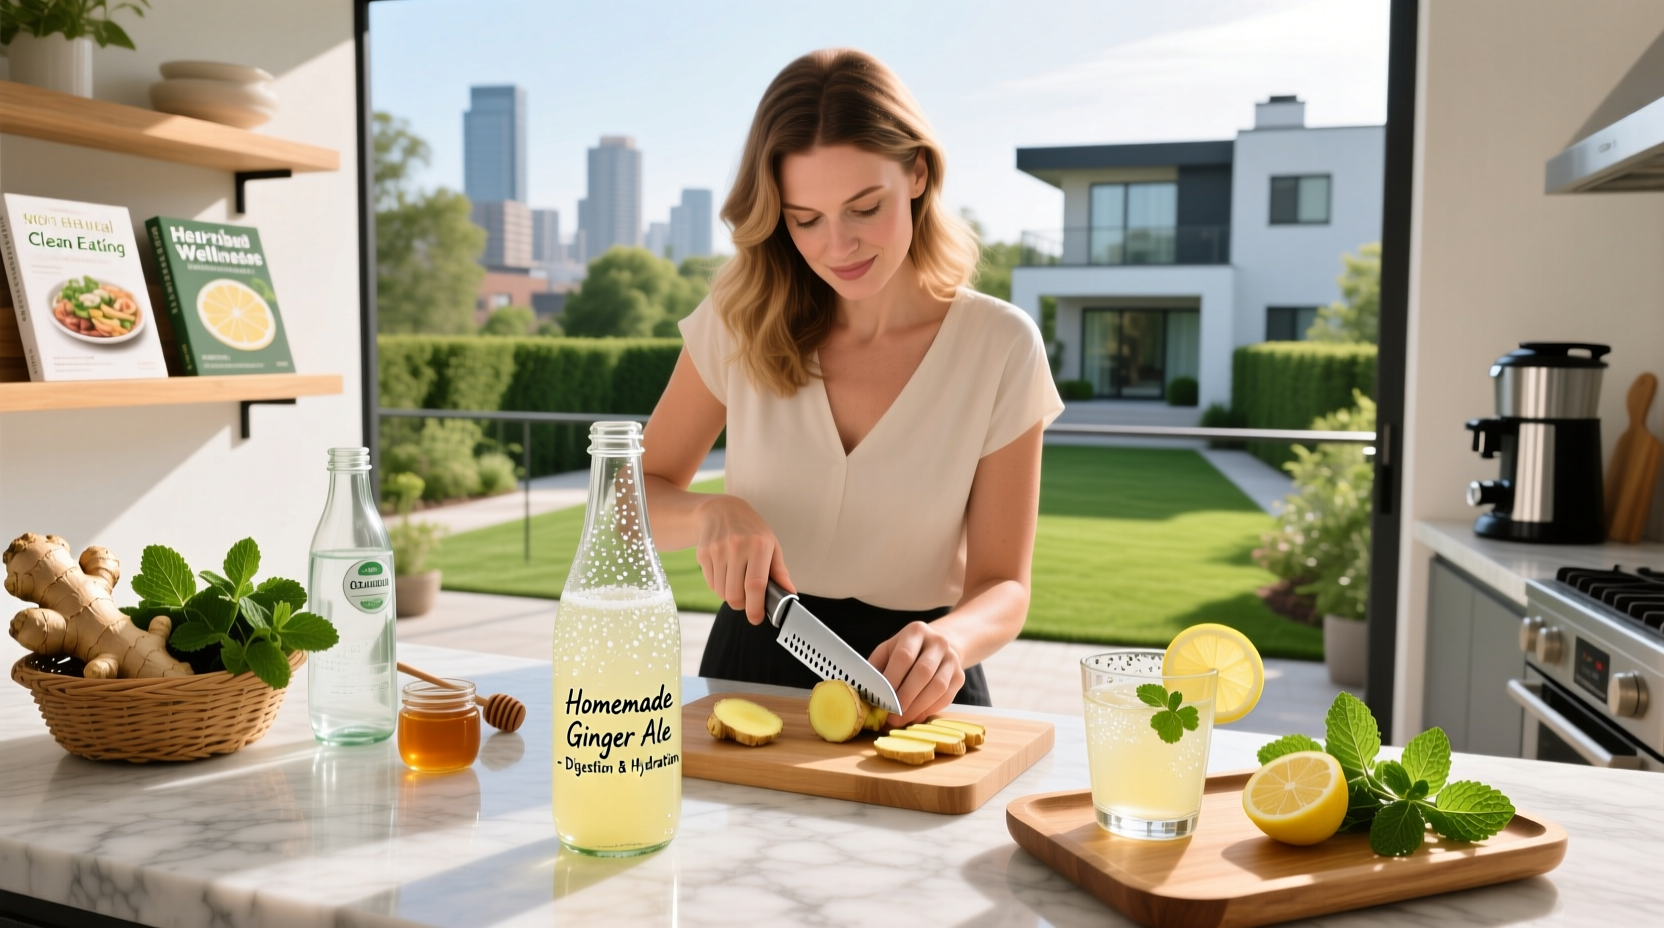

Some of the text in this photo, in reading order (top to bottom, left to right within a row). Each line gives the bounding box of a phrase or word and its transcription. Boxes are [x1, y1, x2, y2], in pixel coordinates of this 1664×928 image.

[28, 231, 125, 258] Clean Eating
[566, 684, 673, 715] Homemade
[567, 716, 672, 759] Ginger Ale
